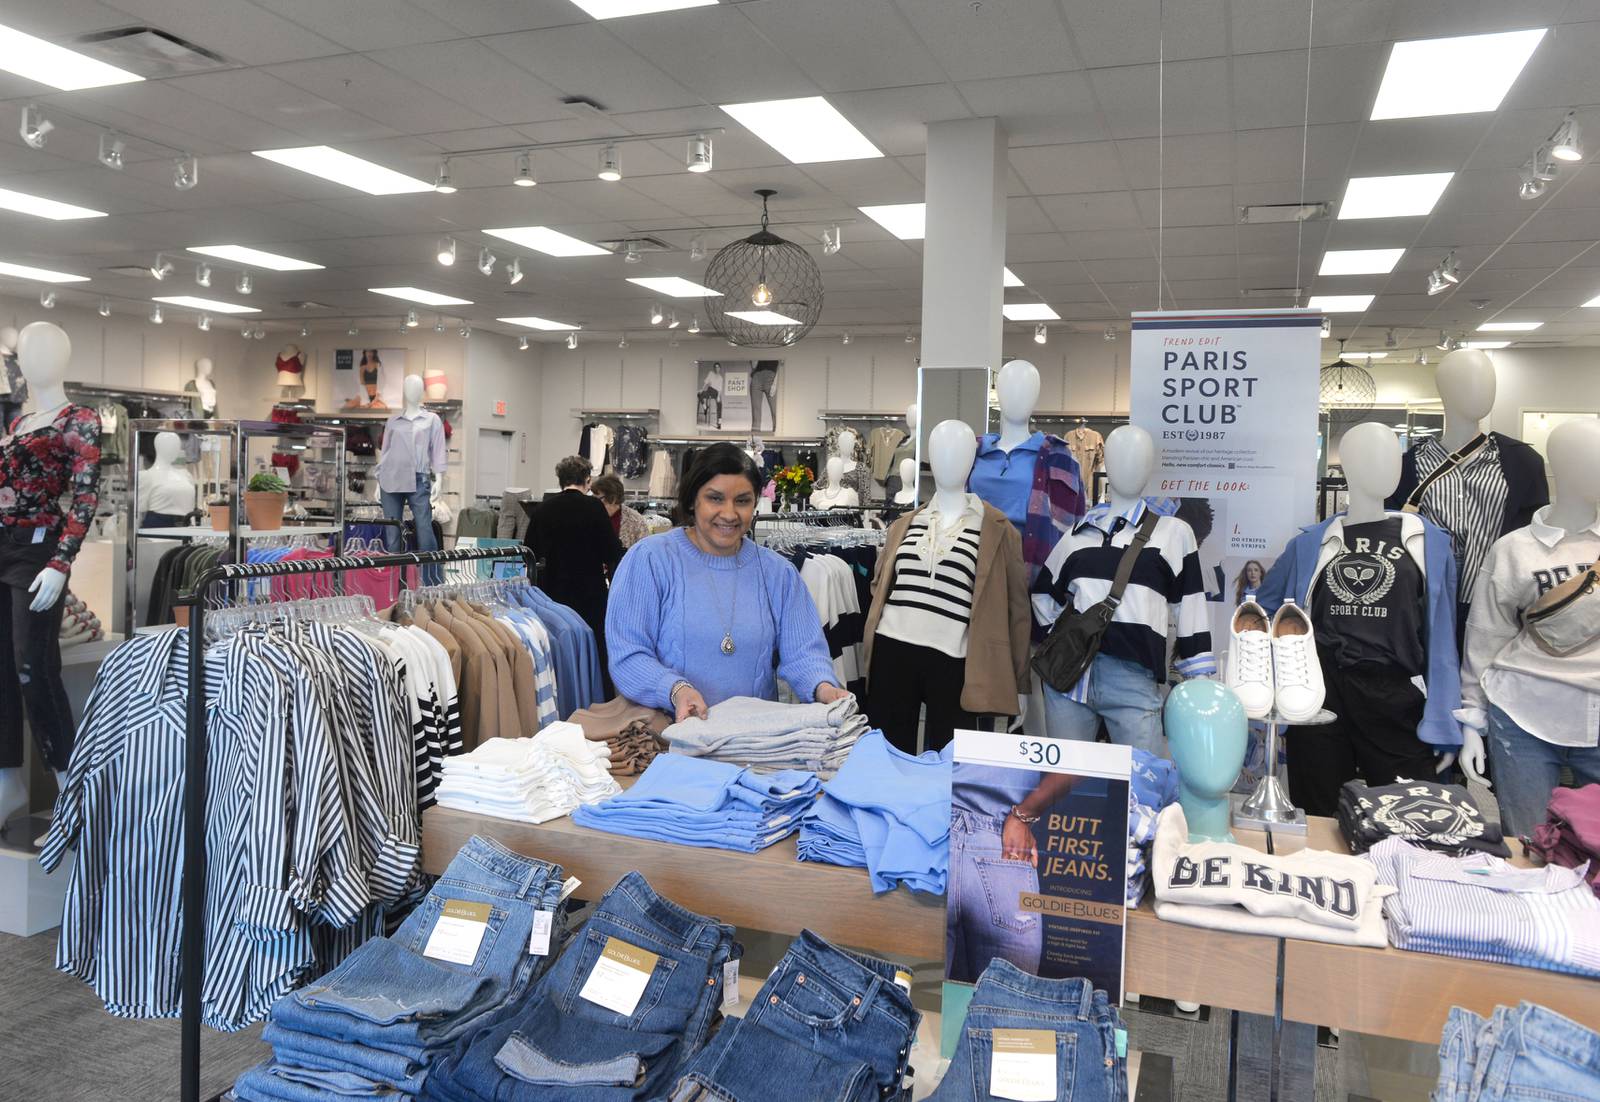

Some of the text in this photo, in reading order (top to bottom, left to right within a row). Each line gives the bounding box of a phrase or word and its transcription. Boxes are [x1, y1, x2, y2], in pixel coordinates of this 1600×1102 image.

[1163, 336, 1222, 346] TREND EDIT
[1164, 350, 1247, 371] PARIS
[1162, 377, 1258, 397] SPORT
[1161, 404, 1237, 424] CLUB
[1162, 431, 1226, 440] EST 1987
[1161, 480, 1183, 490] GET
[1188, 481, 1209, 491] THE
[1340, 538, 1405, 560] ARIS
[1330, 605, 1388, 618] SPORT CLUB
[1020, 741, 1061, 766] $30
[1048, 814, 1102, 836] BUTT
[1048, 836, 1105, 862] FIRST,
[1043, 857, 1113, 882] JEANS.
[1049, 884, 1093, 896] INTRODUCING
[1168, 856, 1361, 920] BE KIND
